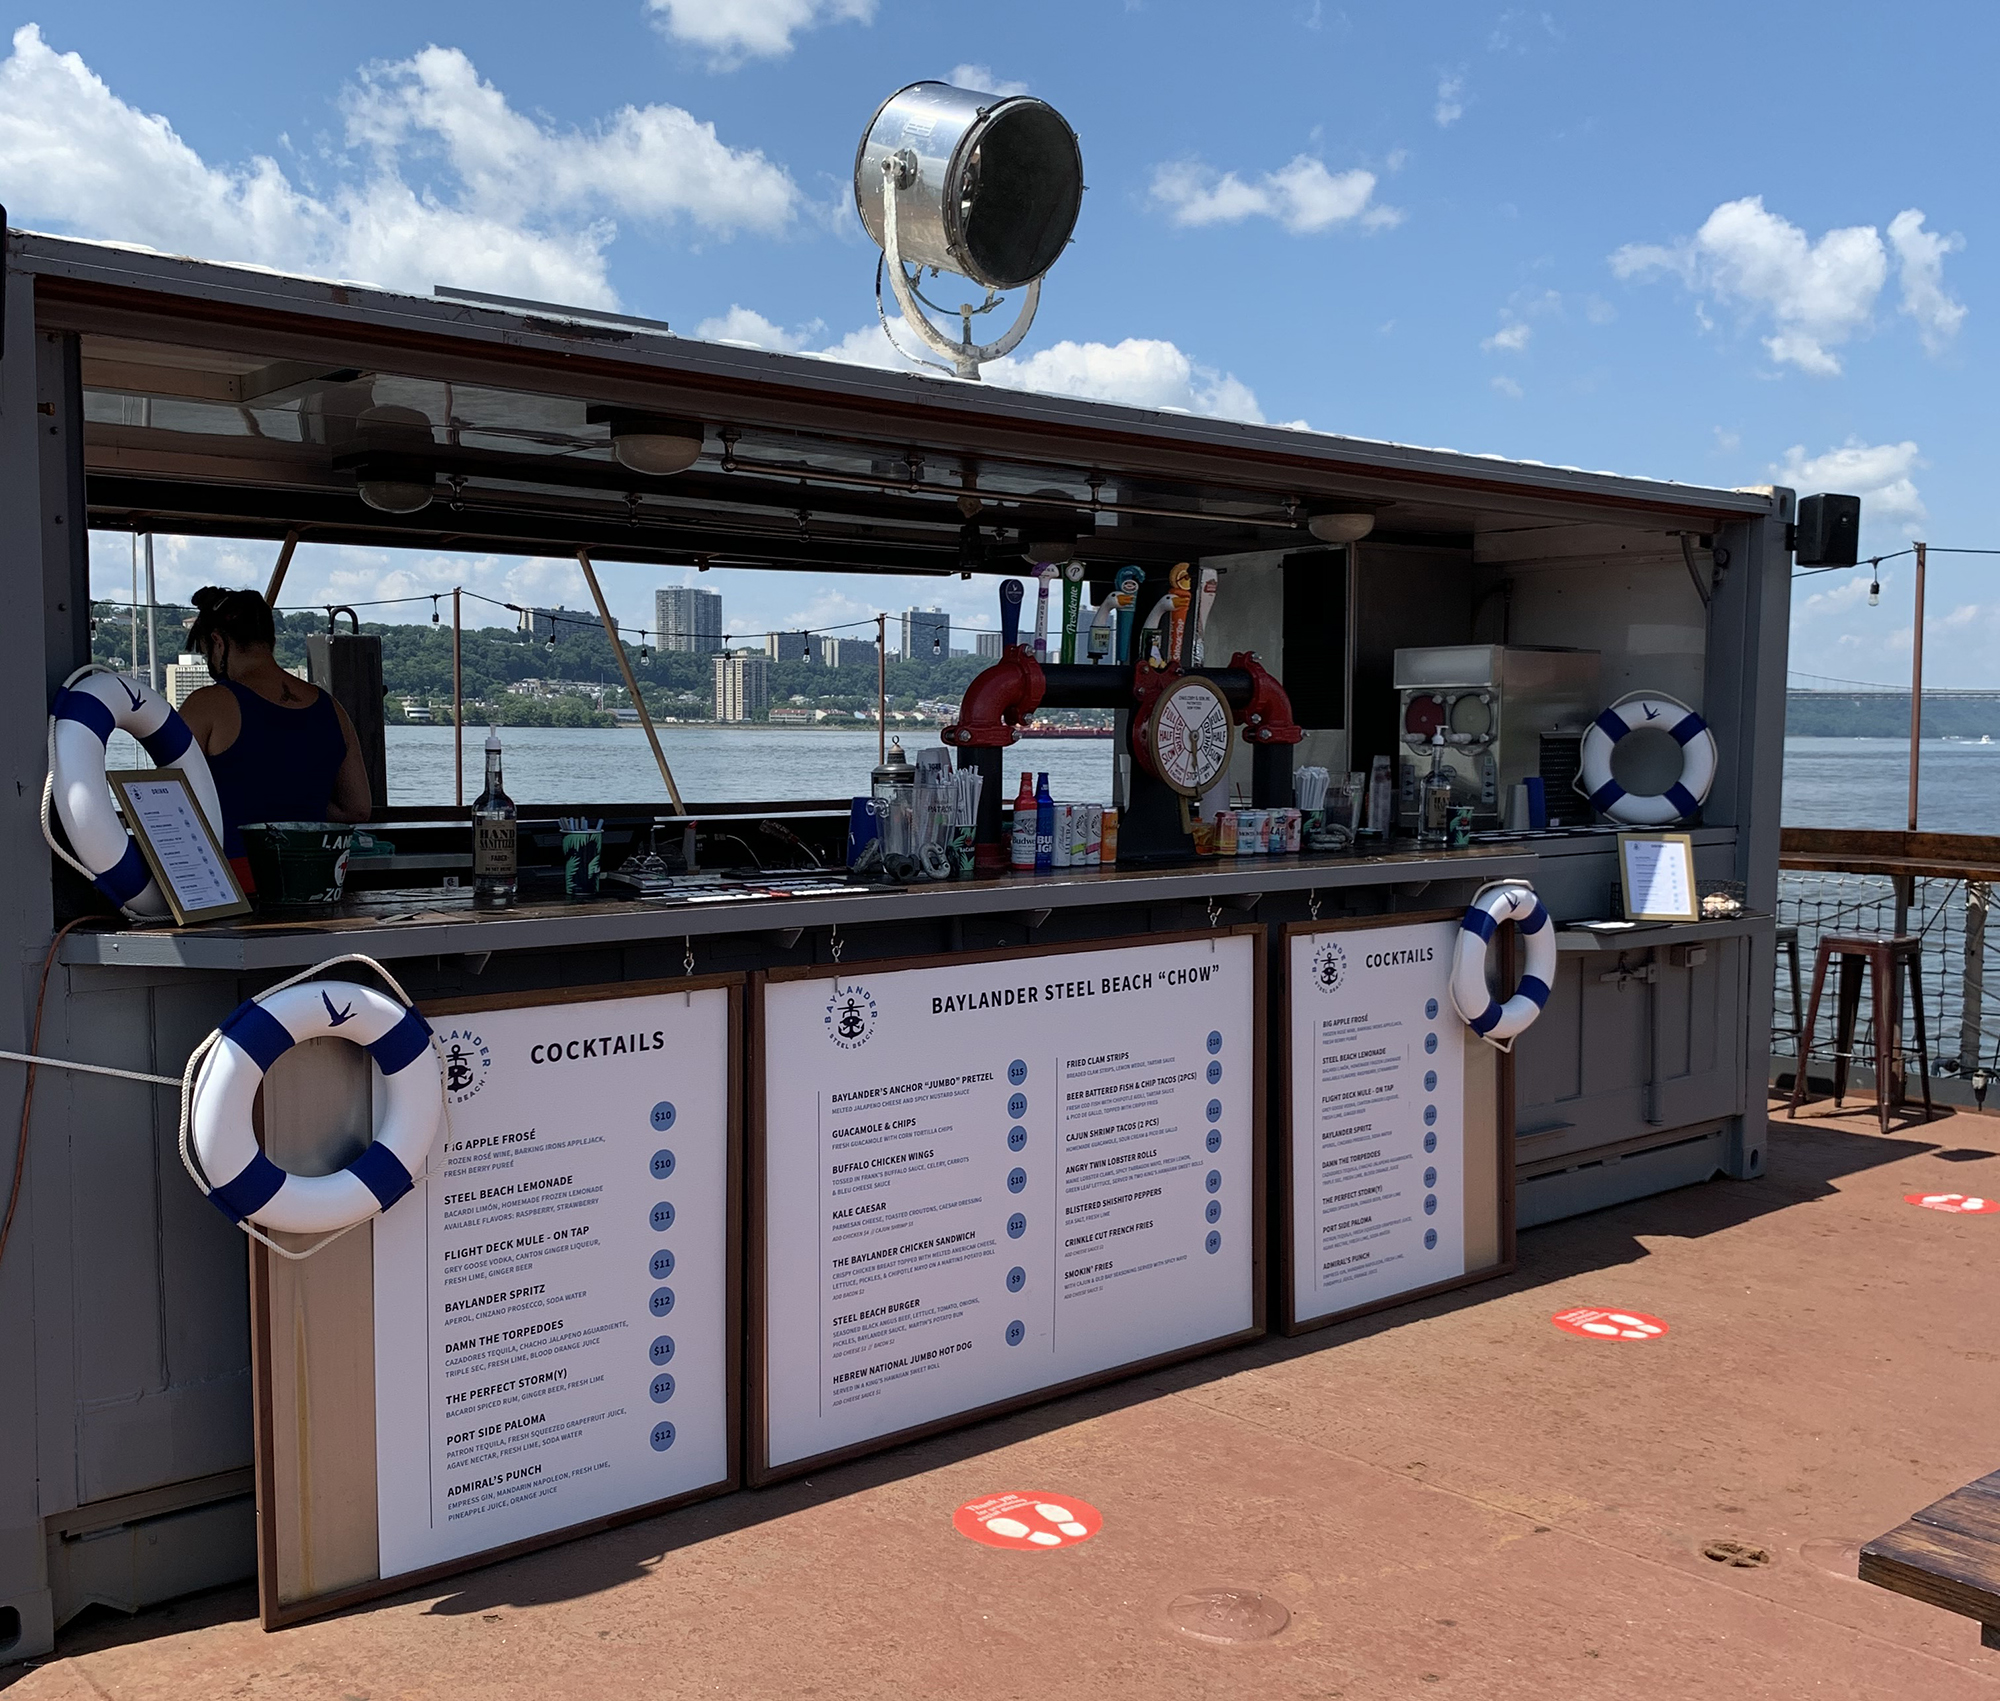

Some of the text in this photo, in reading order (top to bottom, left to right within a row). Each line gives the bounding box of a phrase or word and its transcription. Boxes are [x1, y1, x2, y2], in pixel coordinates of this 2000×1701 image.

[1066, 586, 1079, 635] Presidente
[1163, 707, 1176, 724] FULL
[1210, 709, 1223, 725] FULL
[1159, 730, 1172, 742] HALF
[1213, 731, 1226, 742] HALF
[1161, 749, 1175, 765] SLOW
[1186, 772, 1197, 780] STOP
[480, 829, 514, 838] HAND
[1366, 947, 1432, 968] COCKTAILS
[932, 986, 1037, 1014] BAYLANDER
[1045, 979, 1094, 1000] STEEL
[1102, 973, 1151, 993] BEACH
[824, 986, 878, 1024] BAYLANDER
[1333, 1017, 1349, 1026] APPLE
[1351, 1013, 1368, 1023] FROSÉ
[531, 1031, 663, 1064] COCKTAILS
[830, 1028, 874, 1049] STEEL BEACH
[1066, 1051, 1128, 1068] FRIED CLAM STRIPS
[1322, 1047, 1386, 1064] STEEL BEACH LEMONADE
[1012, 1068, 1023, 1077] $15
[457, 1079, 485, 1103] BEACH
[889, 1082, 922, 1094] ANCHOR
[962, 1072, 992, 1084] PRETZEL
[1012, 1102, 1023, 1110] $11
[656, 1112, 671, 1121] $10
[832, 1123, 882, 1138] GUACAMOLE
[892, 1118, 915, 1128] CHIPS
[465, 1136, 498, 1149] APPLE
[502, 1129, 535, 1143] FROSÉ
[1012, 1134, 1023, 1143] $14
[443, 1160, 513, 1177] FRESH BERRY PUREÉ
[655, 1160, 670, 1170] $10
[832, 1149, 933, 1174] BUFFALO CHICKEN WINGS
[1066, 1149, 1156, 1174] ANGRY TWIN LOBSTER ROLLS
[1011, 1176, 1023, 1185] $10
[444, 1175, 572, 1205] STEEL BEACH LEMONADE
[444, 1207, 474, 1218] BACARDI
[501, 1196, 539, 1208] HOMEMADE
[541, 1191, 567, 1201] FROZEN
[568, 1185, 602, 1196] LEMONADE
[1065, 1187, 1161, 1215] BLISTERED SHISHITO PEPPERS
[444, 1198, 598, 1230] AVAILABLE FLAVORS: RASPBERRY, STRAWBERRY
[655, 1211, 670, 1221] $11
[832, 1202, 886, 1219] KALE CAESAR
[1011, 1221, 1022, 1230] $12
[1065, 1220, 1153, 1247] CRINKLE CUT FRENCH FRIES
[444, 1245, 481, 1260] FLIGHT
[486, 1240, 513, 1252] DECK
[516, 1234, 544, 1247] MULE
[553, 1229, 568, 1241] ON
[571, 1225, 588, 1236] TAP
[833, 1230, 975, 1268] THE BAYLANDER CHICKEN SANDWICH
[655, 1259, 669, 1270] $11
[1012, 1275, 1020, 1284] $9
[445, 1284, 544, 1312] BAYLANDER SPRITZ
[655, 1297, 670, 1308] $12
[444, 1290, 586, 1326] APEROL, CINZANO PROSECCO, SODA WATER
[833, 1298, 919, 1326] STEEL BEACH BURGER
[445, 1319, 563, 1353] DAMN THE TORPEDOES
[1012, 1329, 1019, 1337] $5
[655, 1345, 669, 1356] $11
[833, 1340, 972, 1384] HEBREW NATIONAL JUMBO HOT DOG
[447, 1368, 566, 1404] THE PERFECT STORM(Y)
[655, 1382, 670, 1393] $12
[446, 1374, 604, 1418] BACARDI SPICED RUM, GINGER BEER, FRESH LIME
[446, 1413, 545, 1445] PORT SIDE PALOMA
[655, 1430, 670, 1442] $12
[506, 1464, 541, 1481] PUNCH
[448, 1486, 556, 1521] PINEAPPLE JUICE, ORANGE JUICE
